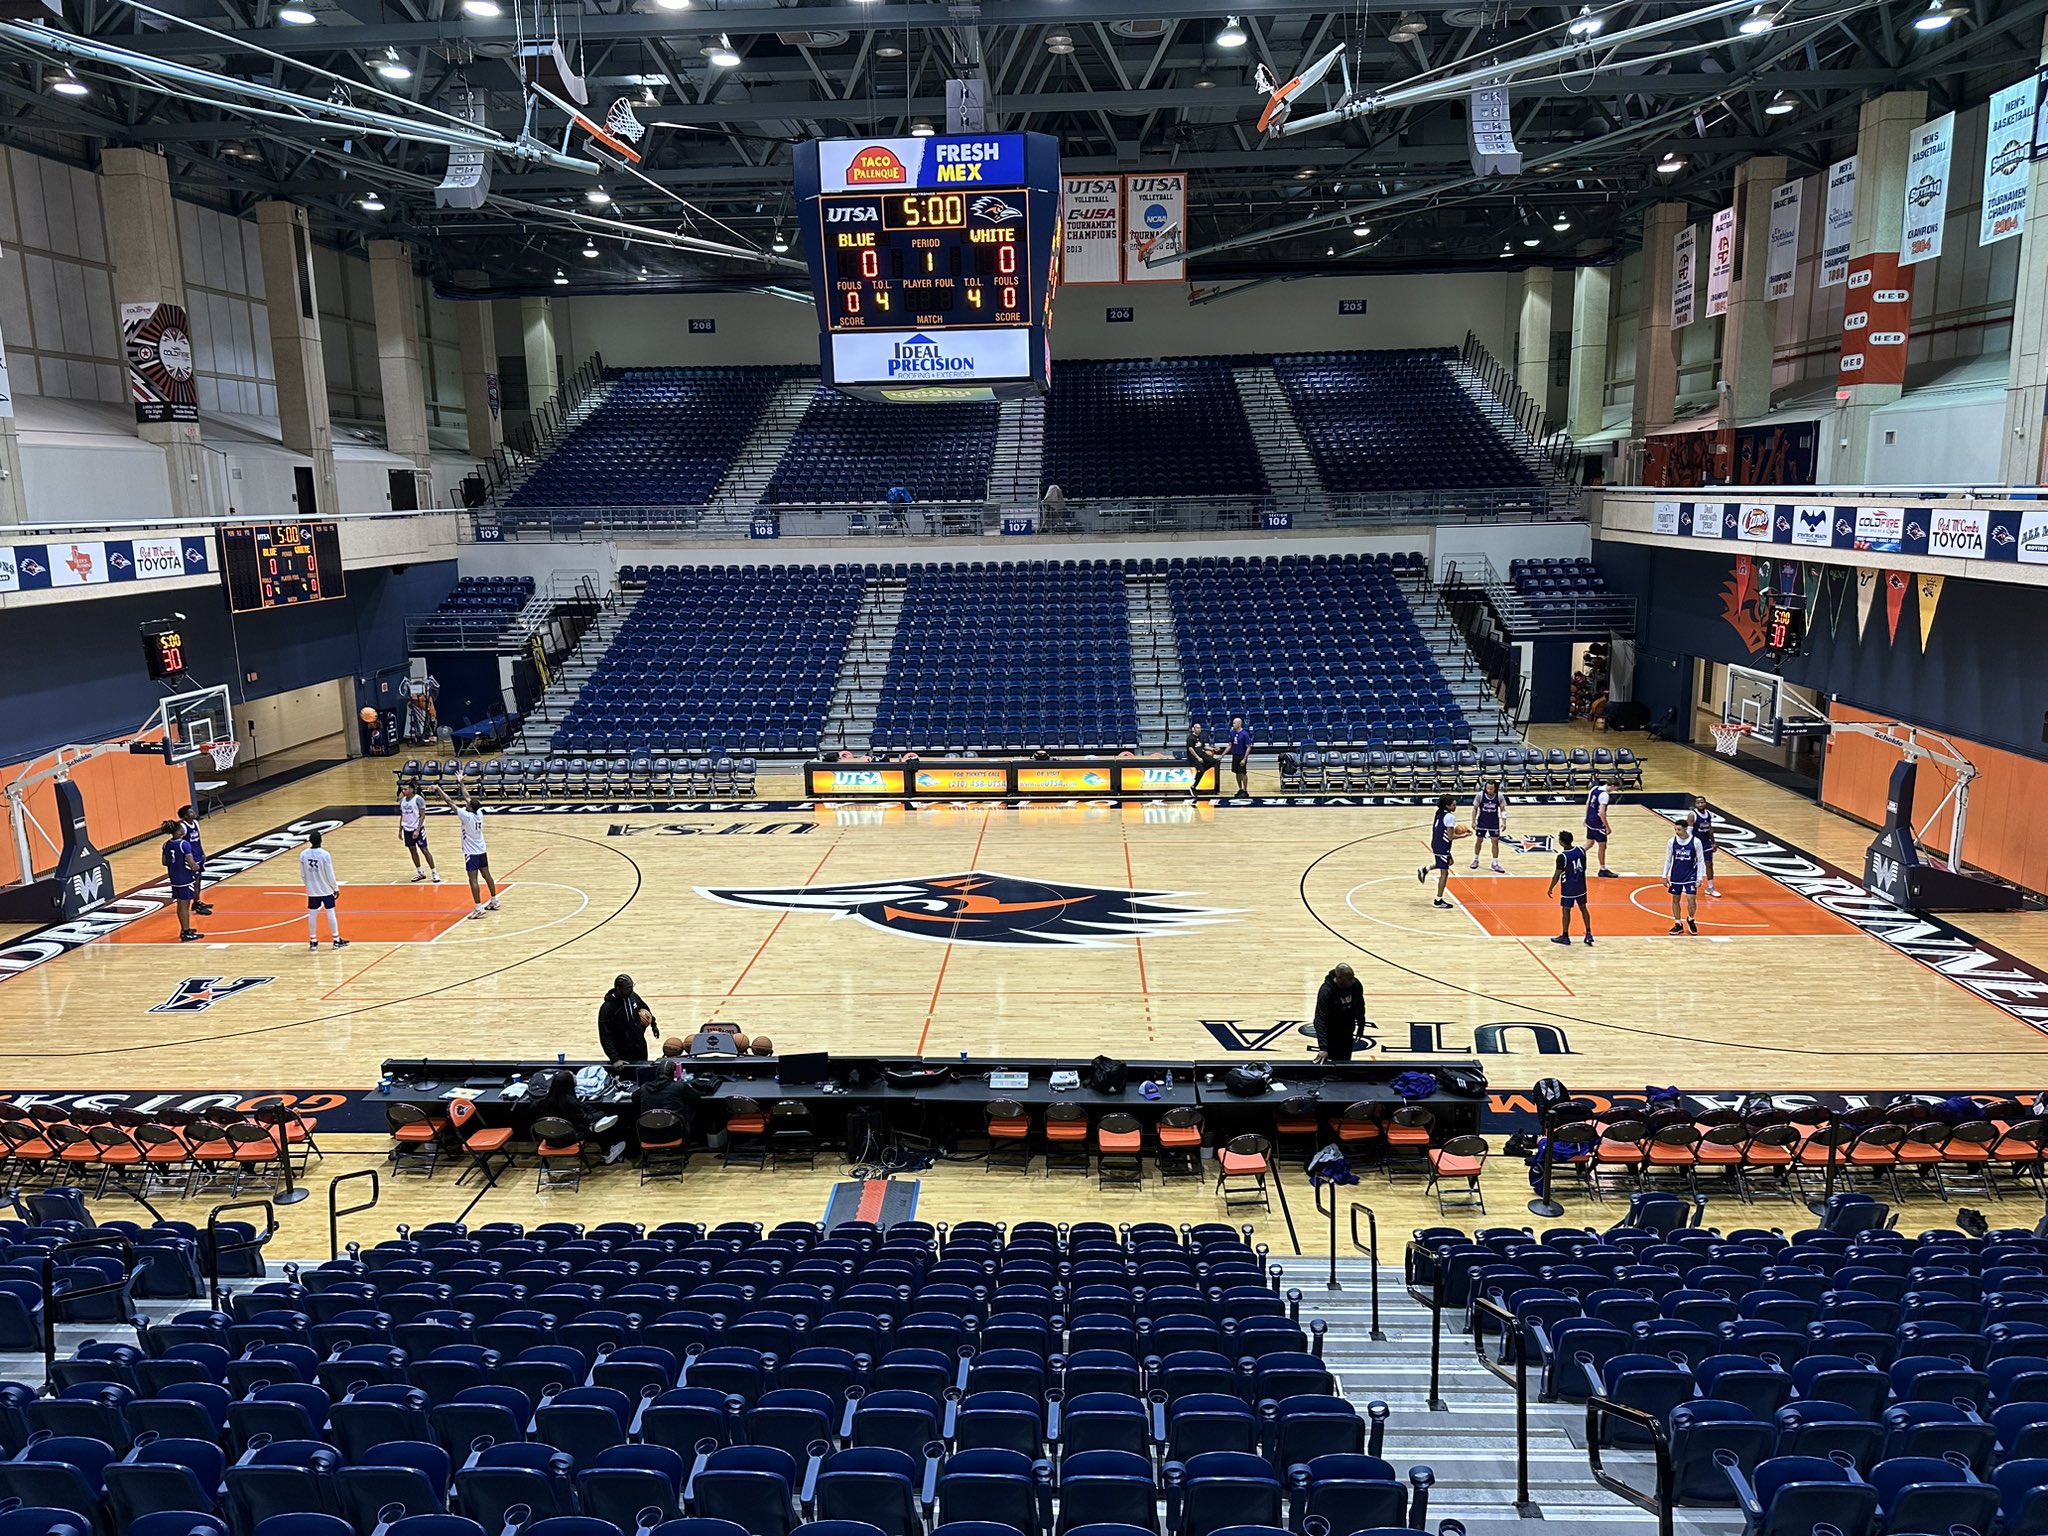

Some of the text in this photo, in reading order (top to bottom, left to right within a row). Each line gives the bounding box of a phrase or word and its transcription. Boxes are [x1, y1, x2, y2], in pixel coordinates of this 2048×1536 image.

[1993, 105, 2036, 132] BASKETBALL
[936, 143, 999, 162] FRESH
[1912, 142, 1946, 163] BASKETBALL
[861, 156, 890, 167] TACO
[854, 167, 900, 179] PALENQUE
[937, 164, 982, 182] MEX
[1068, 180, 1117, 194] UTSA
[1132, 178, 1182, 192] UTSA
[827, 206, 878, 222] UTSA
[903, 196, 961, 226] 5:00
[1988, 199, 2026, 220] CHAMPIONS
[1067, 221, 1116, 229] TOURNAMENT
[1908, 223, 1938, 239] CHAMPIONS
[838, 233, 875, 247] BLUE
[970, 228, 1015, 243] WHITE
[1067, 230, 1117, 239] CHAMPIONS
[911, 239, 940, 248] PERIOD
[1066, 245, 1082, 253] 2013
[862, 250, 878, 277] 0
[926, 252, 933, 271] 1
[1000, 246, 1015, 273] 0
[837, 281, 862, 290] FOULS
[872, 280, 892, 289] T.O.L.
[903, 278, 955, 288] PLAYER FOUL
[964, 278, 984, 287] T.O.L.
[994, 277, 1019, 286] FOULS
[848, 291, 860, 312] 0
[875, 292, 890, 311] 4
[967, 289, 981, 308] 4
[1004, 287, 1016, 308] 0
[1344, 302, 1362, 311] 205
[839, 316, 865, 326] SCORE
[917, 315, 943, 325] MATCH
[995, 312, 1021, 322] SCORE
[1110, 311, 1130, 319] 206
[692, 322, 711, 330] 208
[894, 341, 942, 359] IDEAL
[888, 357, 974, 376] PRECISION
[898, 372, 931, 380] ROOFING
[936, 370, 975, 379] EXTERIORS
[1009, 523, 1027, 532] 107
[1268, 517, 1287, 526] 106
[1858, 517, 1901, 528] COLDFIRE
[1938, 517, 1950, 533] Red
[277, 526, 299, 543] 5:00
[480, 530, 499, 539] 109
[755, 526, 773, 535] 108
[1932, 531, 1983, 550] TOYOTA
[140, 546, 150, 559] Red
[262, 548, 277, 557] BLUE
[136, 558, 182, 572] TOYOTA
[270, 558, 277, 575] 0
[288, 560, 292, 571] 1
[307, 555, 314, 571] 0
[1774, 610, 1790, 625] 5:00
[160, 634, 181, 649] 5:00
[1769, 624, 1786, 647] 30
[163, 648, 182, 672] 30
[1873, 731, 1904, 747] Schelde
[833, 771, 884, 785] UTSA
[1142, 768, 1196, 784] UTSA
[948, 780, 968, 789] (210)
[607, 822, 820, 837] UTSA
[308, 858, 318, 869] 33
[1572, 858, 1583, 874] 14
